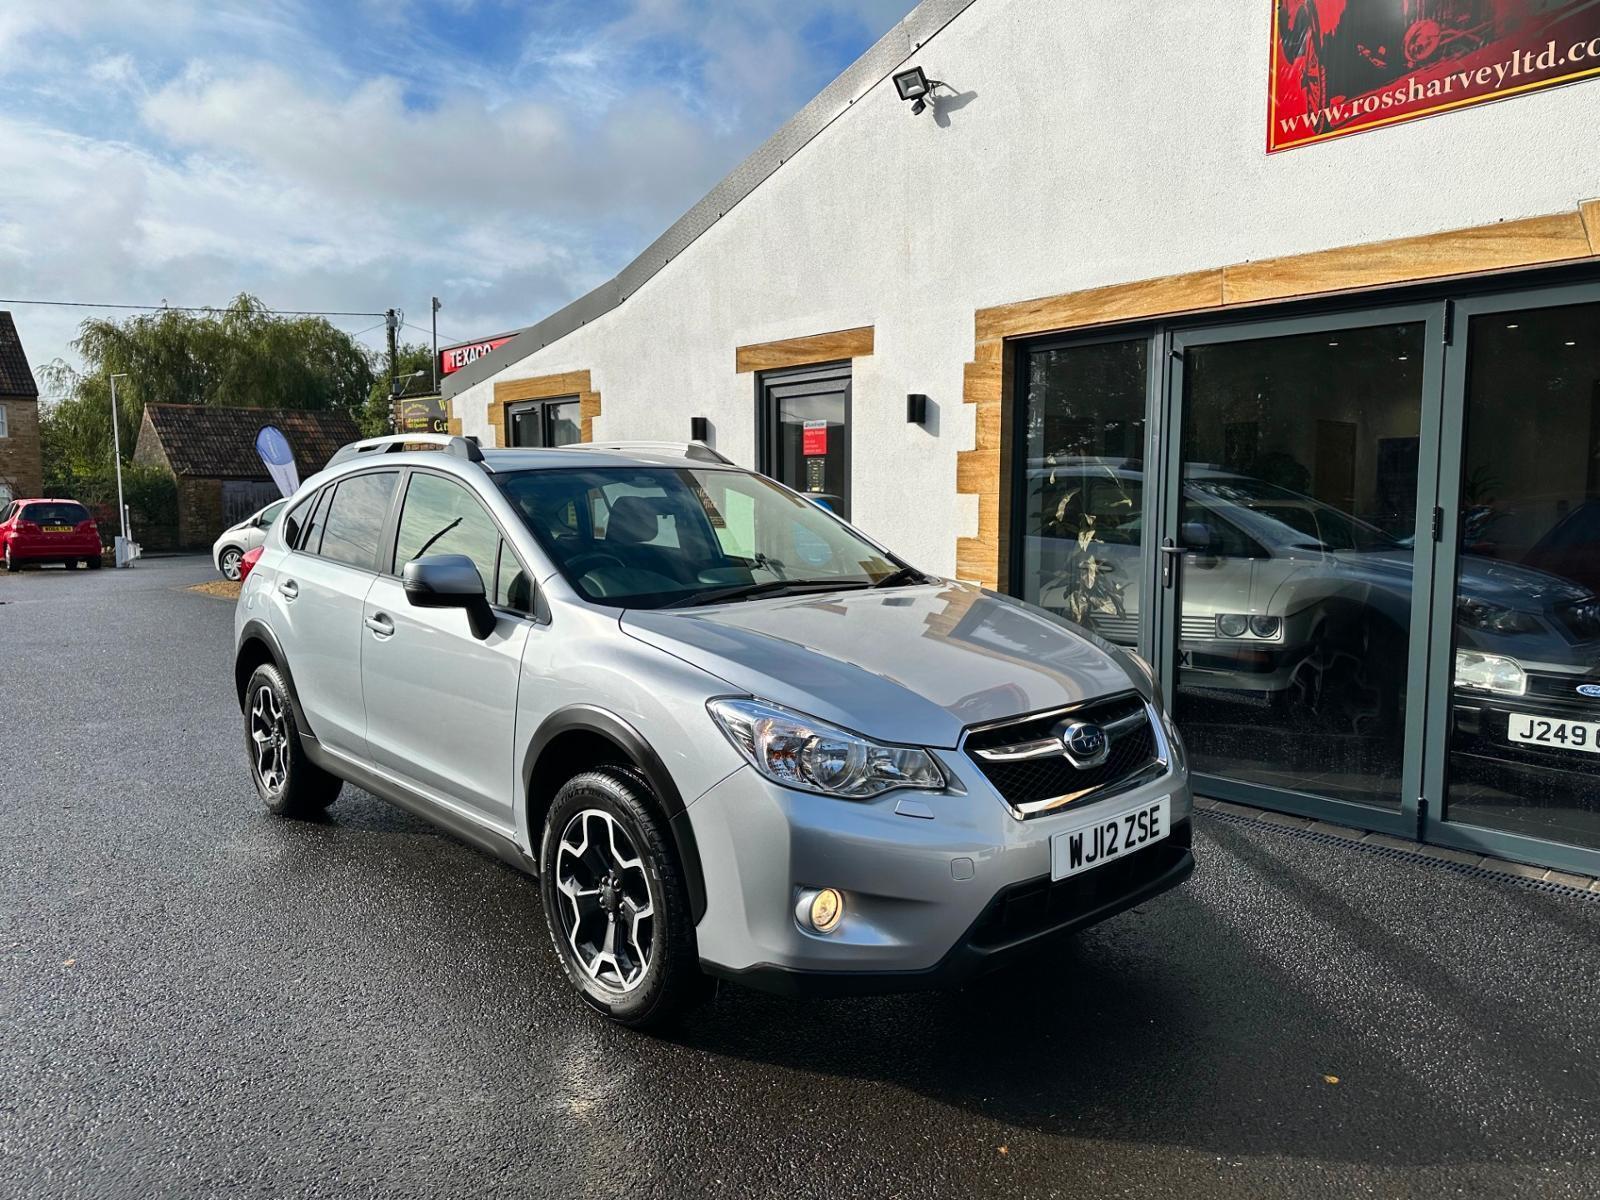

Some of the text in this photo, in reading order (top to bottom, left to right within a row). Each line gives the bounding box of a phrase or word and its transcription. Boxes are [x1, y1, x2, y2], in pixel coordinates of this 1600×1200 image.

[1280, 37, 1600, 133] www.rossharveyltd.co
[1519, 719, 1587, 746] J249
[1069, 804, 1160, 869] WJ12 ZSE
